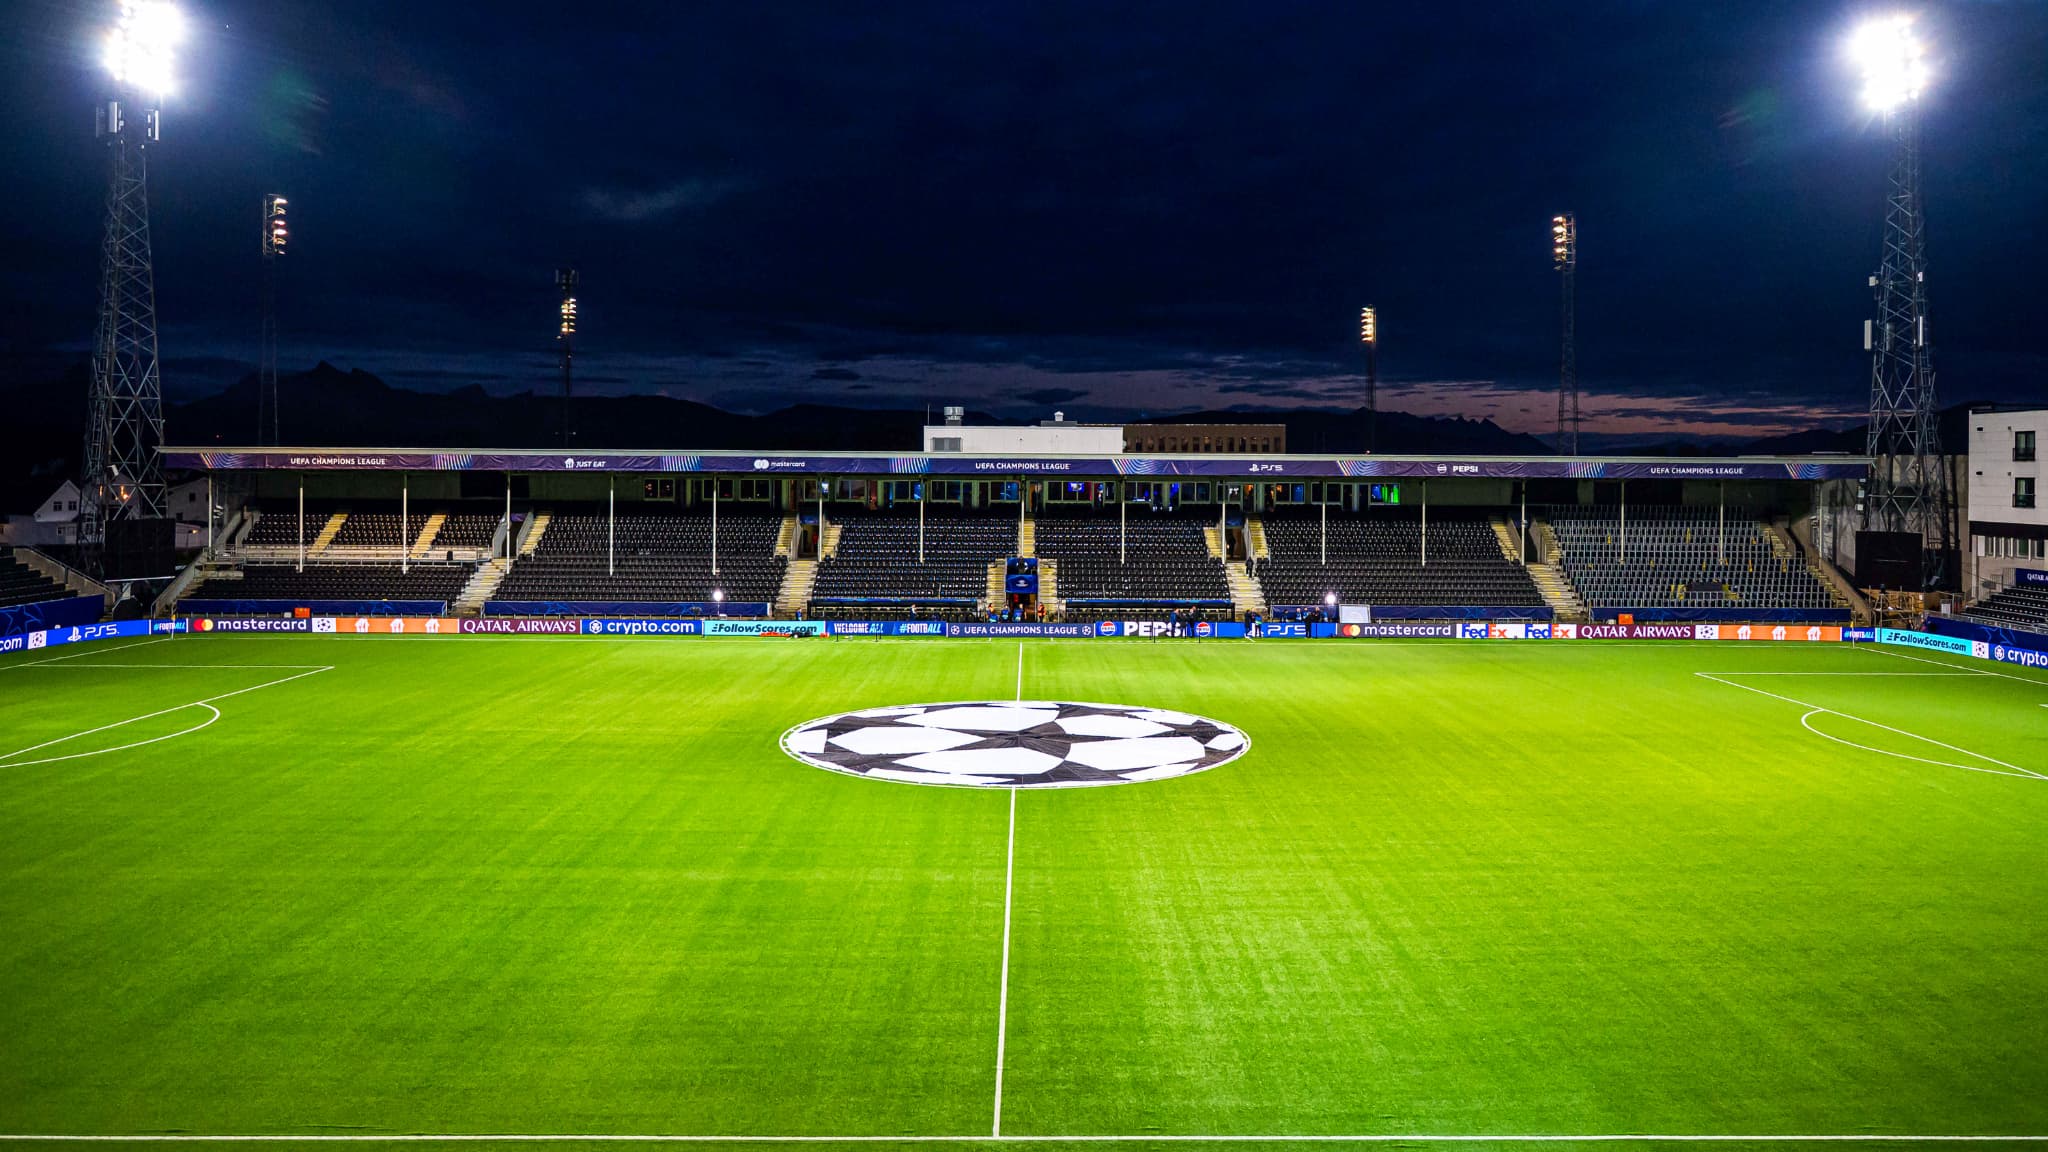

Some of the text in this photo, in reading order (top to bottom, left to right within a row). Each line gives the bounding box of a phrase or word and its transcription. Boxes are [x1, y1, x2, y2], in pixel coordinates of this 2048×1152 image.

[290, 457, 386, 465] UEFA CHAMPIONS LEAGUE
[996, 462, 1039, 470] CHAMPIONS
[1452, 465, 1479, 473] PEPSI
[1671, 467, 1714, 475] CHAMPIONS
[217, 618, 307, 630] mastercard
[463, 620, 577, 633] QATAR AIRWAYS
[607, 620, 695, 633] crypto.com
[834, 623, 884, 633] WELCOME ALL
[900, 623, 942, 634] #FOOTBALL
[1364, 623, 1451, 636] mastercard
[84, 624, 117, 638] PS5
[964, 626, 1078, 635] UEFA CHAMPIONS LEAGUE
[1267, 625, 1307, 636] PS5
[1461, 624, 1507, 638] FedEx
[1525, 624, 1570, 638] FedEx
[1581, 625, 1691, 639] QATAR AIRWAYS
[1893, 633, 1967, 652] FollowScores.com
